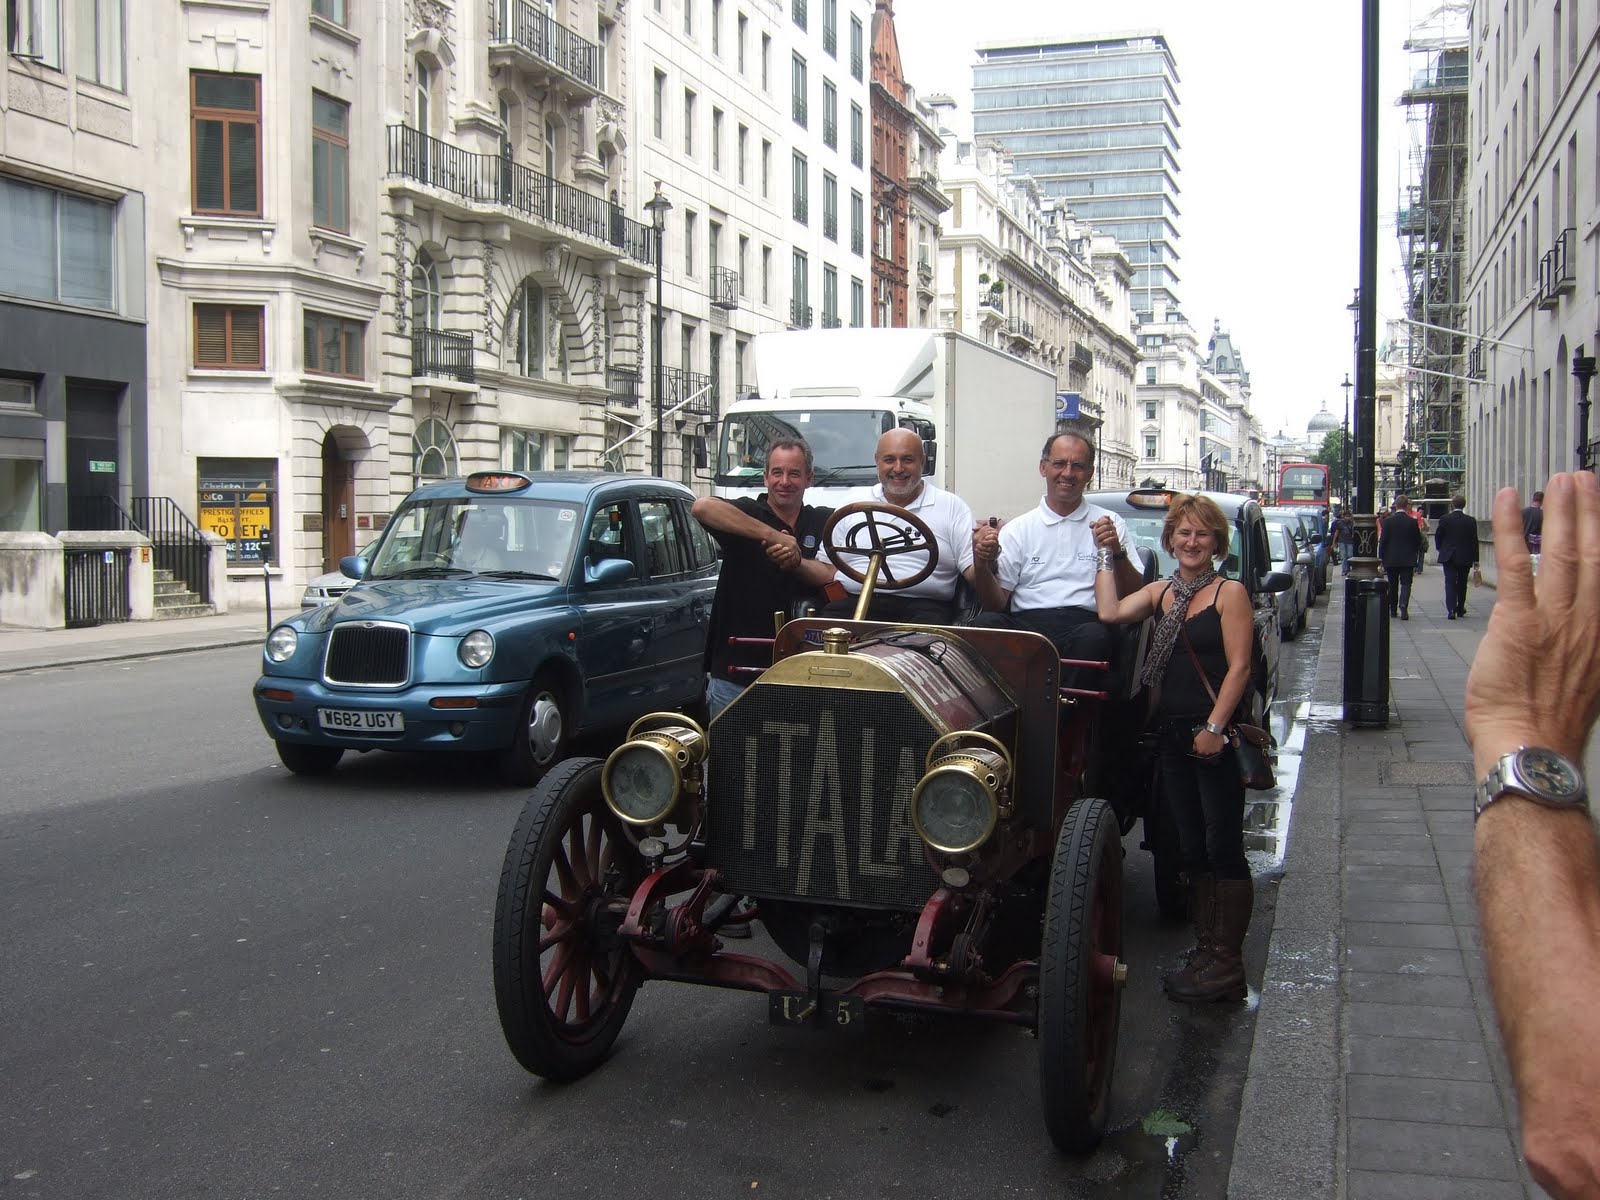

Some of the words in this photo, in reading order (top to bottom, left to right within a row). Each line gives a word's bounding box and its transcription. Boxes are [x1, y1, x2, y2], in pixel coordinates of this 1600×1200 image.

[210, 525, 228, 537] TO
[236, 524, 259, 537] ET
[324, 710, 362, 727] W682
[365, 713, 395, 728] UGY
[743, 709, 926, 899] ITALA
